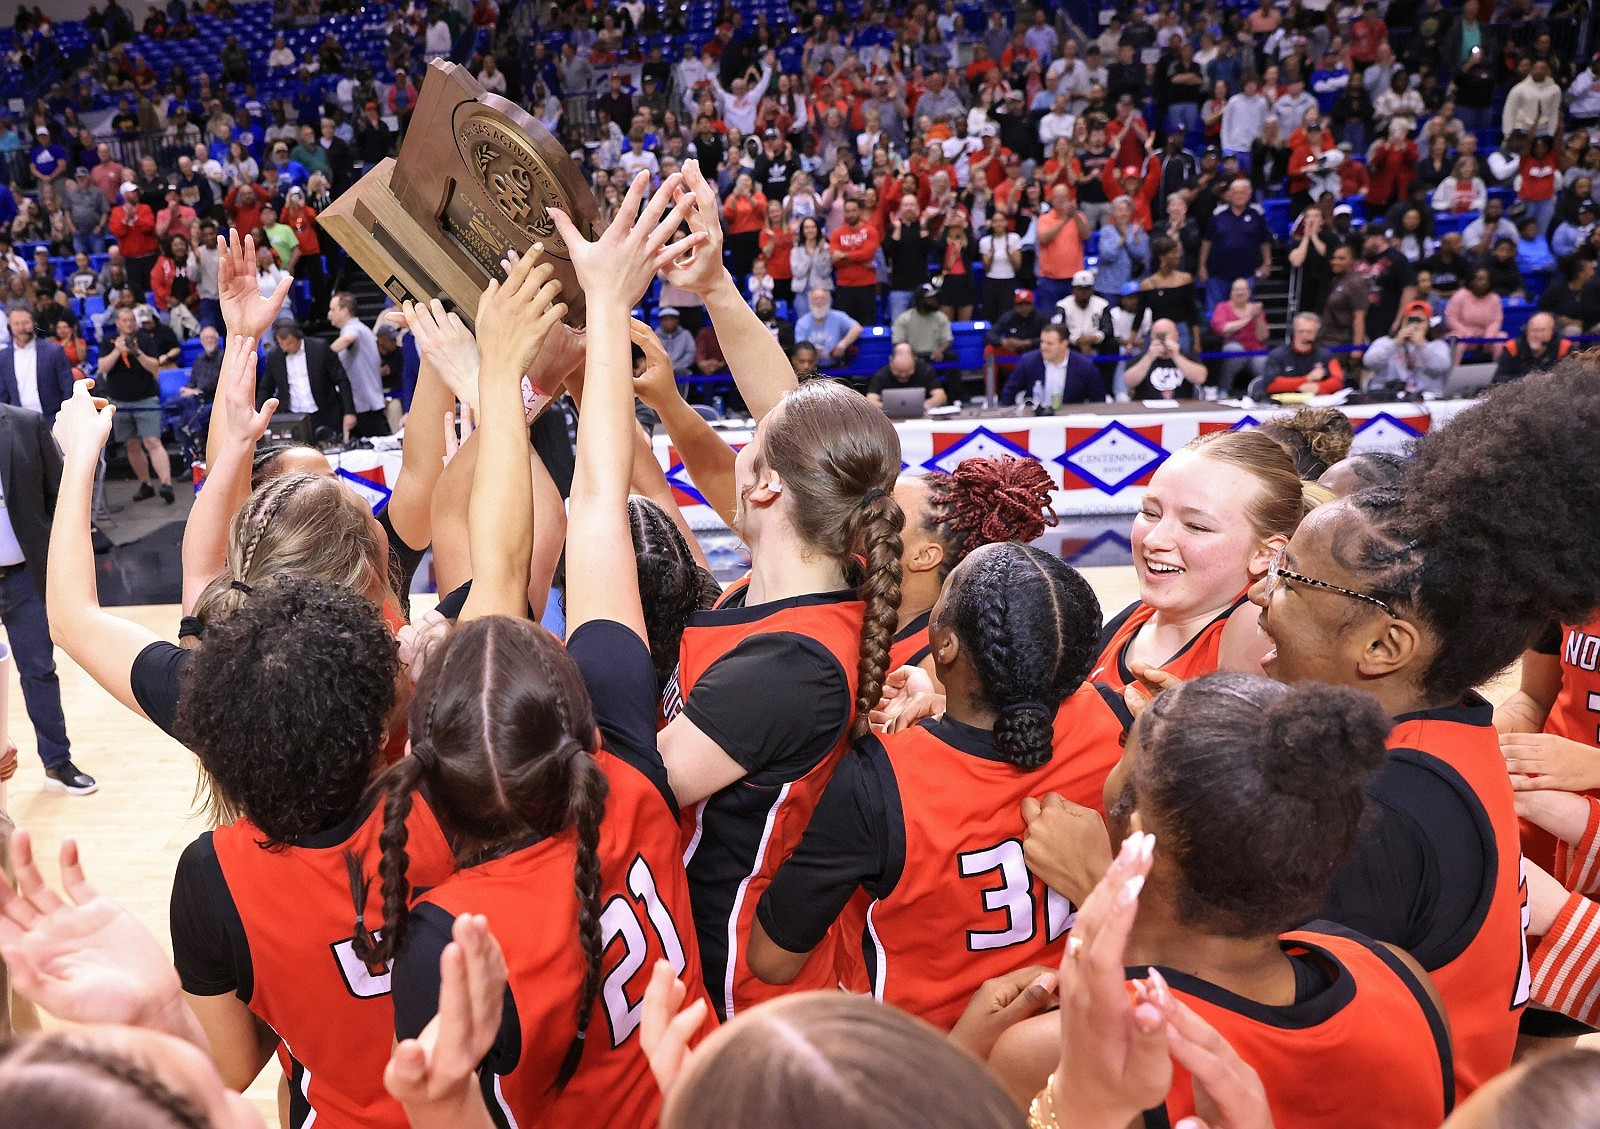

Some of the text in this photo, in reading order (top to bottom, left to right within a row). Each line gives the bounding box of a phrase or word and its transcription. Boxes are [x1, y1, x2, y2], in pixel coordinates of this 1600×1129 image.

[493, 130, 550, 188] ACTIVITIES
[1564, 629, 1600, 672] NO
[600, 852, 686, 1048] 21
